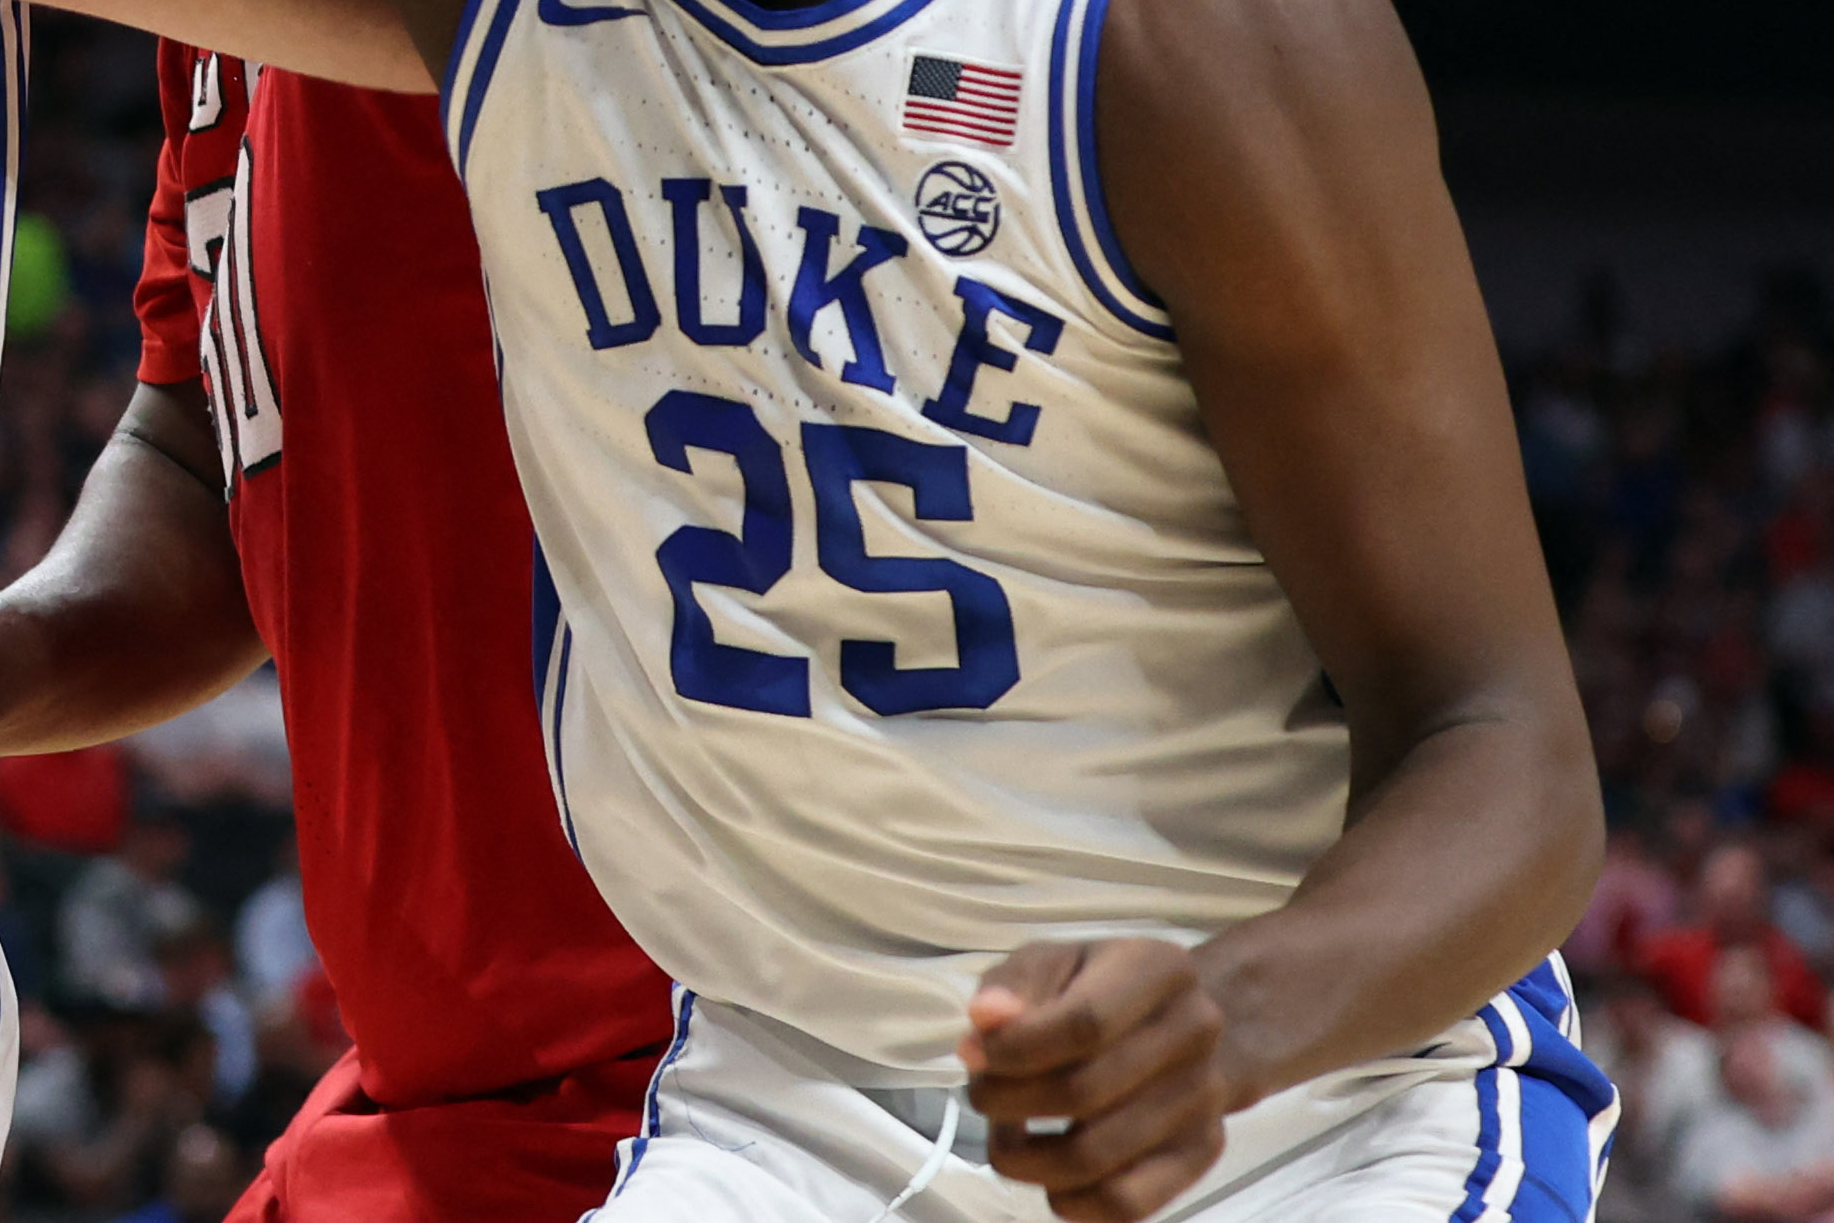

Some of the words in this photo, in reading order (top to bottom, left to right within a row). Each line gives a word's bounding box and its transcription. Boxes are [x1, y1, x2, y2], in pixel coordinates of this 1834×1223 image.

[536, 177, 1065, 447] DUKE
[921, 190, 997, 224] ACC
[643, 389, 1022, 719] 25
